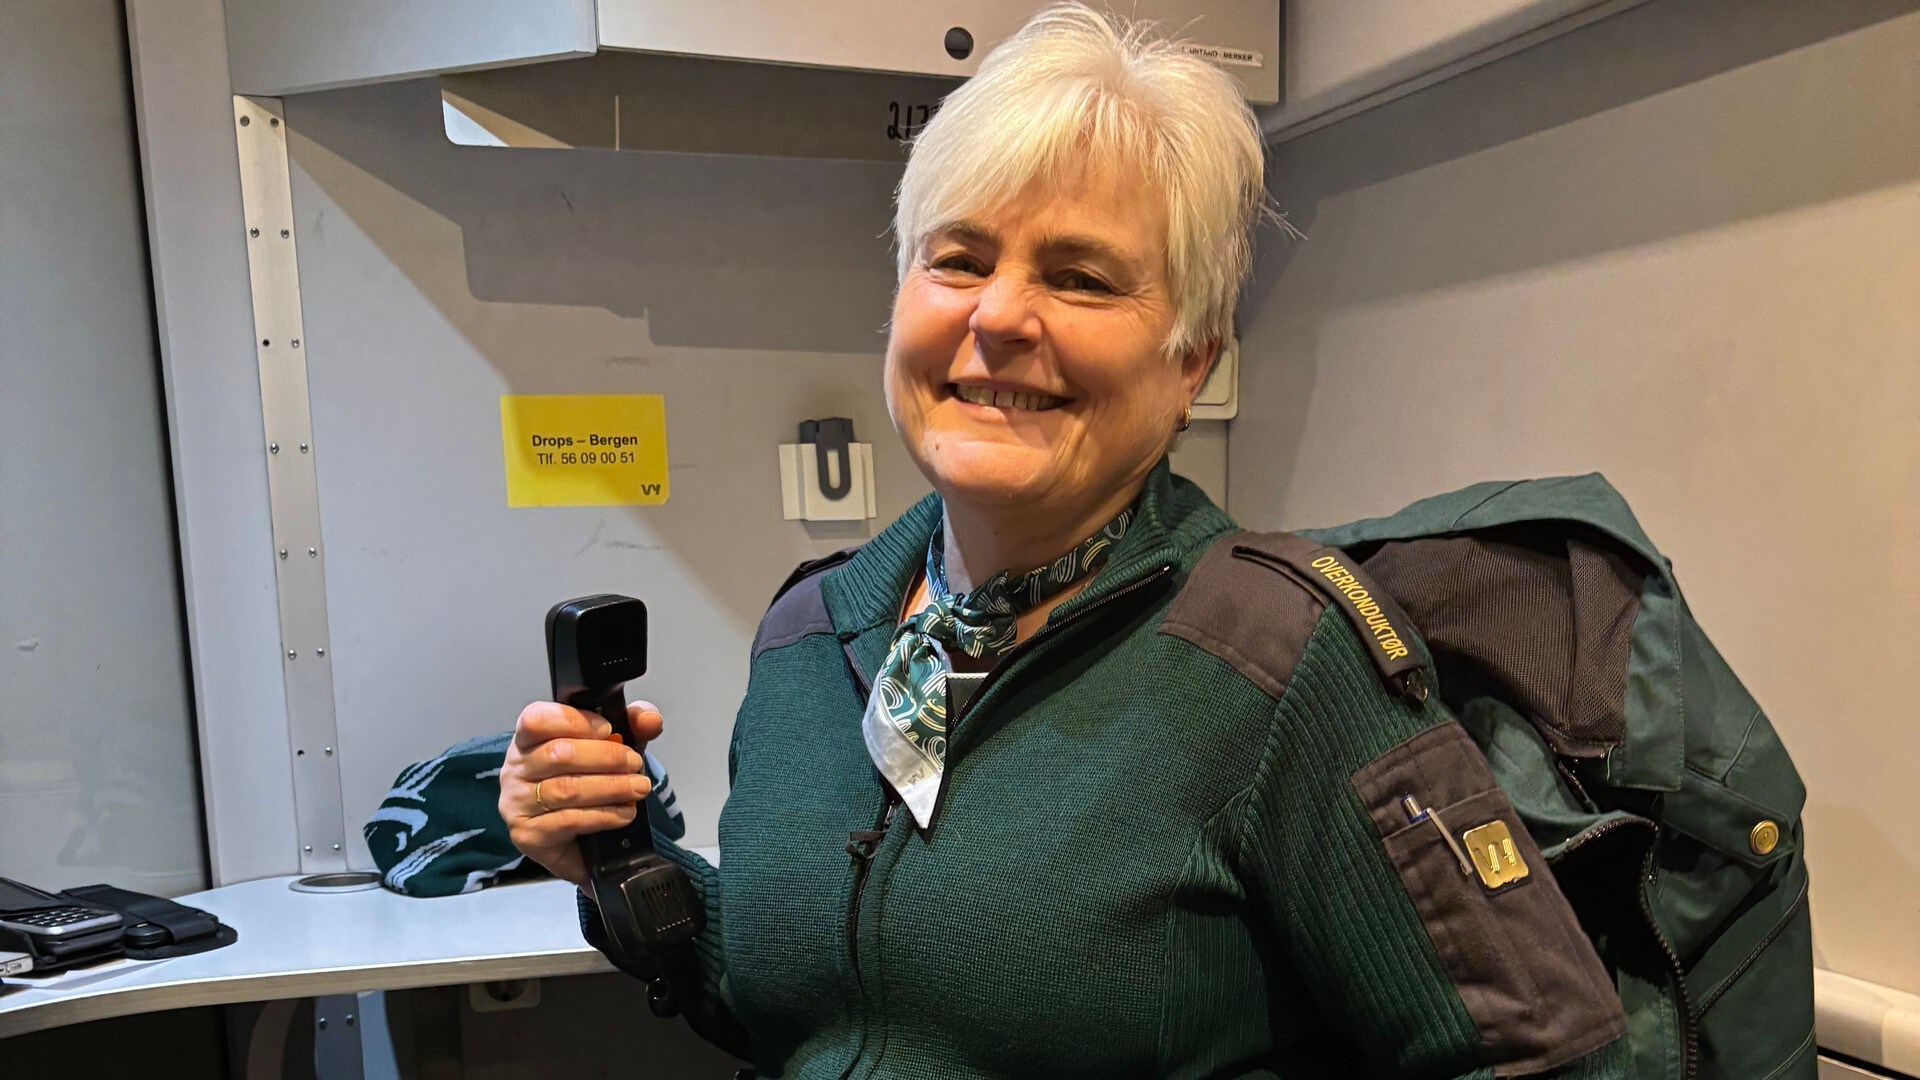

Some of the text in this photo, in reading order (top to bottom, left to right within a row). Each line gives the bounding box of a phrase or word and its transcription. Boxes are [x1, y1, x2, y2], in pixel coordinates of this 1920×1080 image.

[887, 101, 940, 139] 217
[532, 434, 573, 449] Drops
[589, 434, 638, 448] Bergen
[537, 453, 635, 465] Tlf. 56 09 00 51
[1311, 556, 1408, 661] OVERKONDUKTØR
